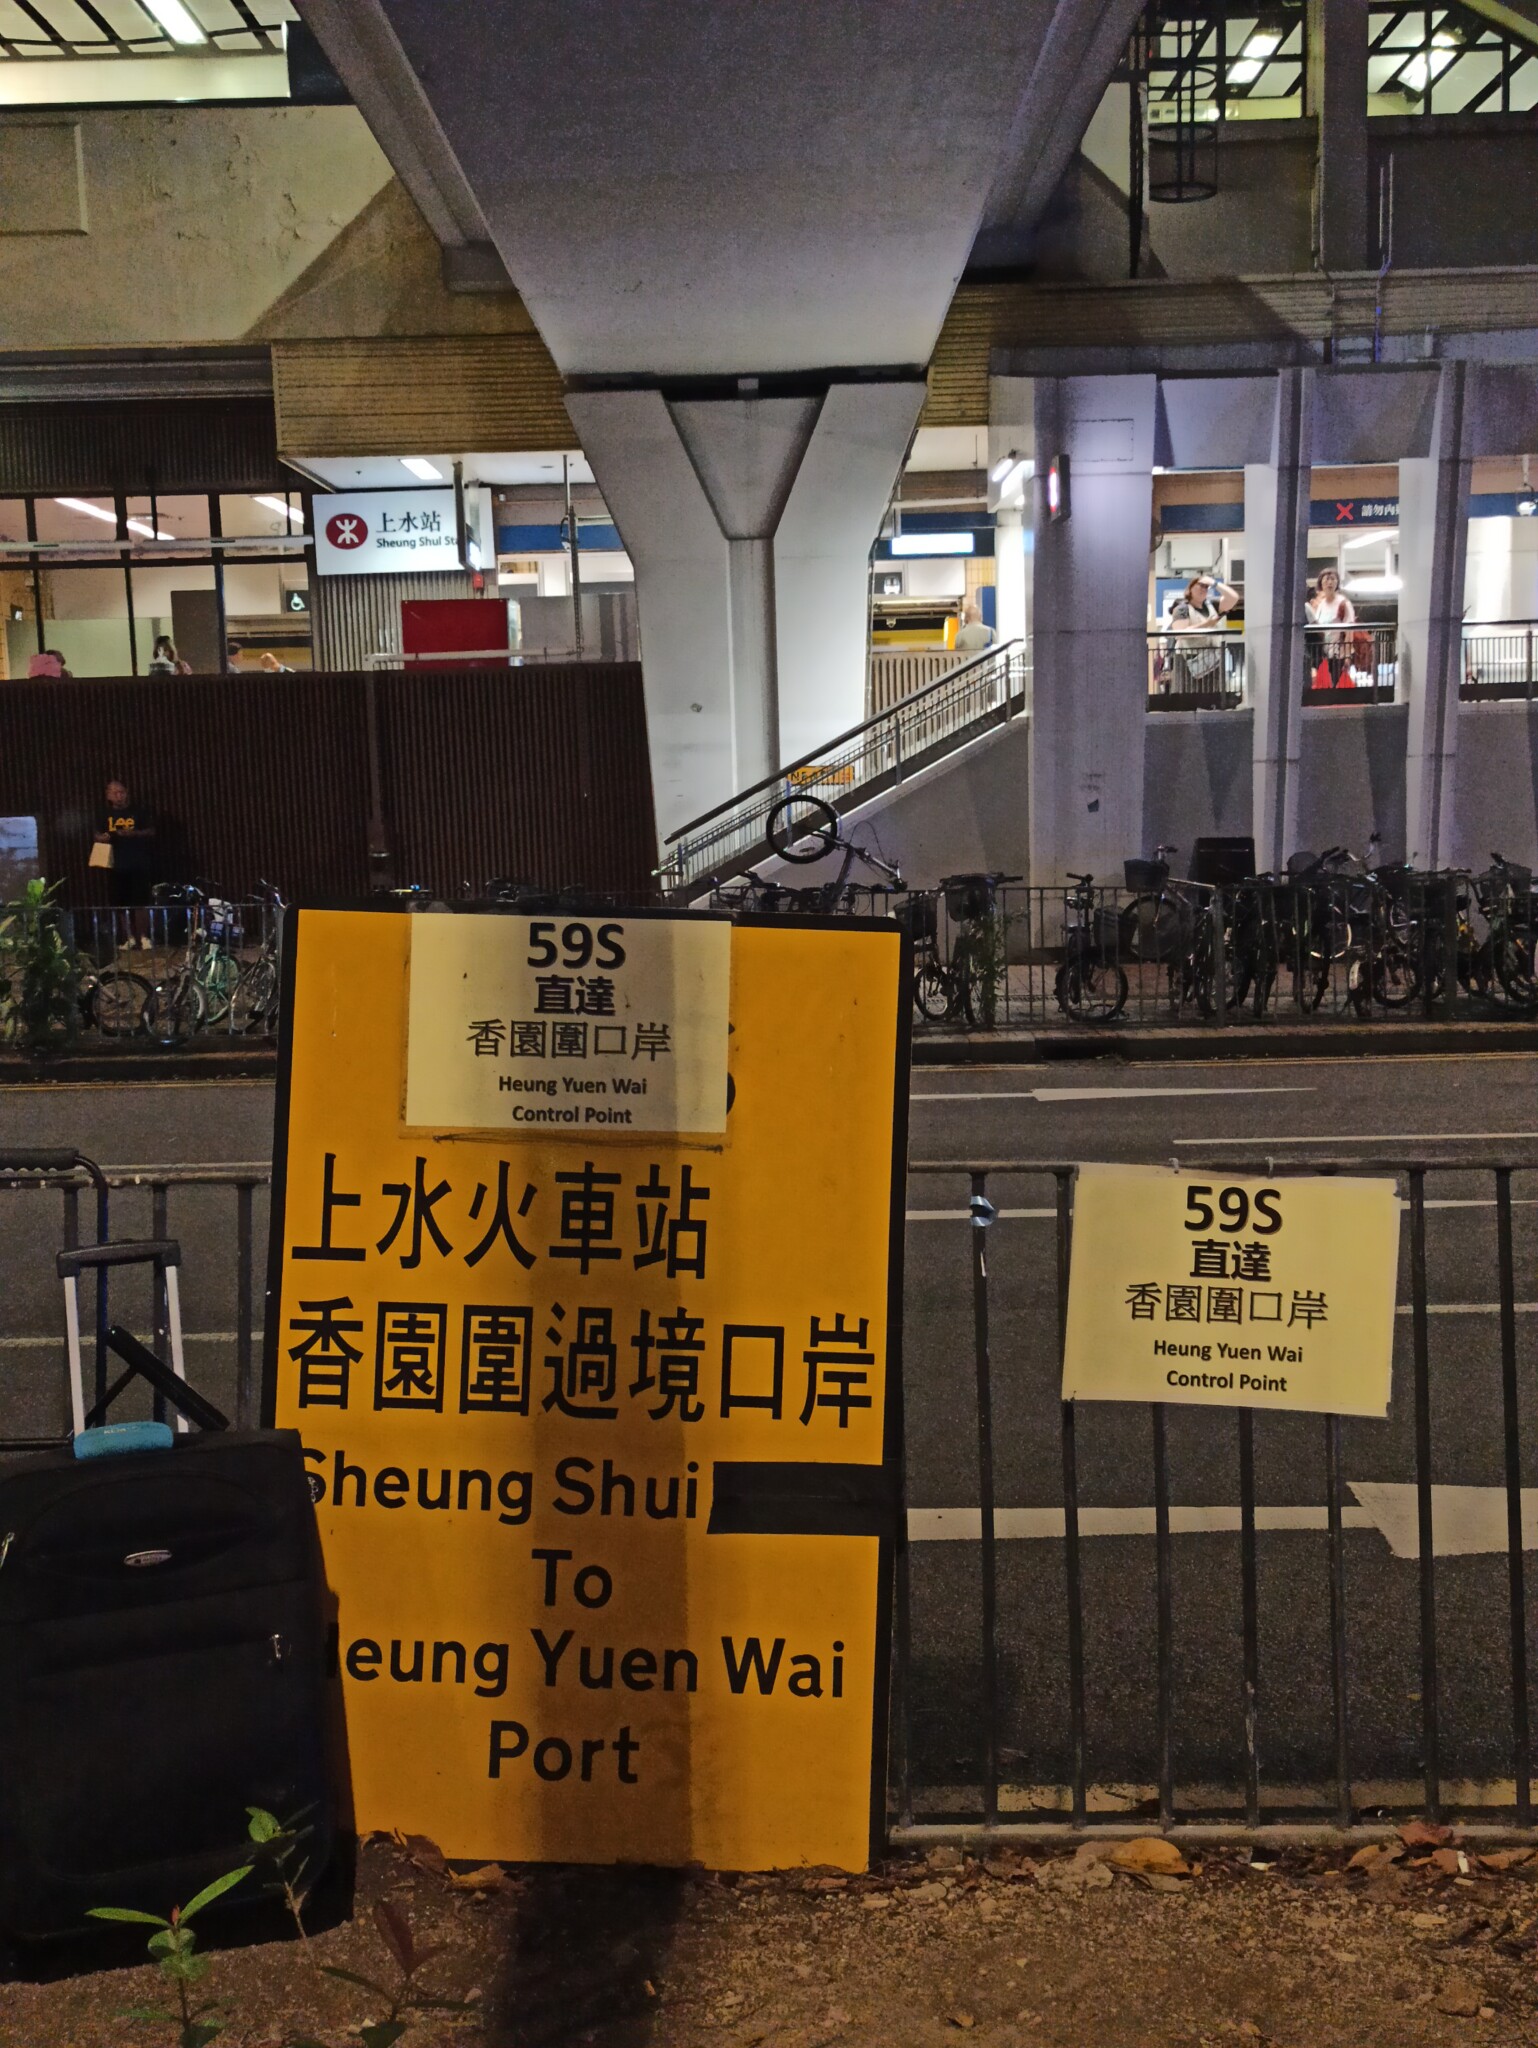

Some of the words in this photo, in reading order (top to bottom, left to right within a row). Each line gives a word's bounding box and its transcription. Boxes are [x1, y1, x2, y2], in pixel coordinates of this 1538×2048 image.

[375, 510, 441, 533] 上水站
[376, 537, 416, 549] Sheung
[419, 536, 442, 547] Shui
[108, 816, 135, 832] Lee
[527, 922, 626, 970] 59S
[533, 974, 616, 1017] 直達
[465, 1018, 672, 1062] 香園圍口岸
[498, 1075, 557, 1096] Heung
[562, 1077, 607, 1094] Yuen
[612, 1078, 647, 1095] Wai
[512, 1105, 580, 1123] Control
[585, 1107, 632, 1124] Point
[291, 1152, 711, 1280] 上水火車站
[1184, 1185, 1283, 1235] 59S
[1189, 1238, 1272, 1283] 直達
[1124, 1281, 1329, 1330] 香園圍口岸
[287, 1296, 875, 1428] 香園圍過境口岸
[1153, 1339, 1212, 1362] Heung
[1217, 1342, 1262, 1361] Yuen
[1267, 1345, 1304, 1363] Wai
[1166, 1370, 1234, 1389] Control
[1239, 1373, 1288, 1392] Point
[301, 1447, 533, 1525] Sheung
[552, 1456, 700, 1519] Shui
[531, 1549, 613, 1610] To
[530, 1628, 699, 1693] Yuen
[720, 1636, 846, 1699] Wai
[488, 1720, 641, 1784] Port
